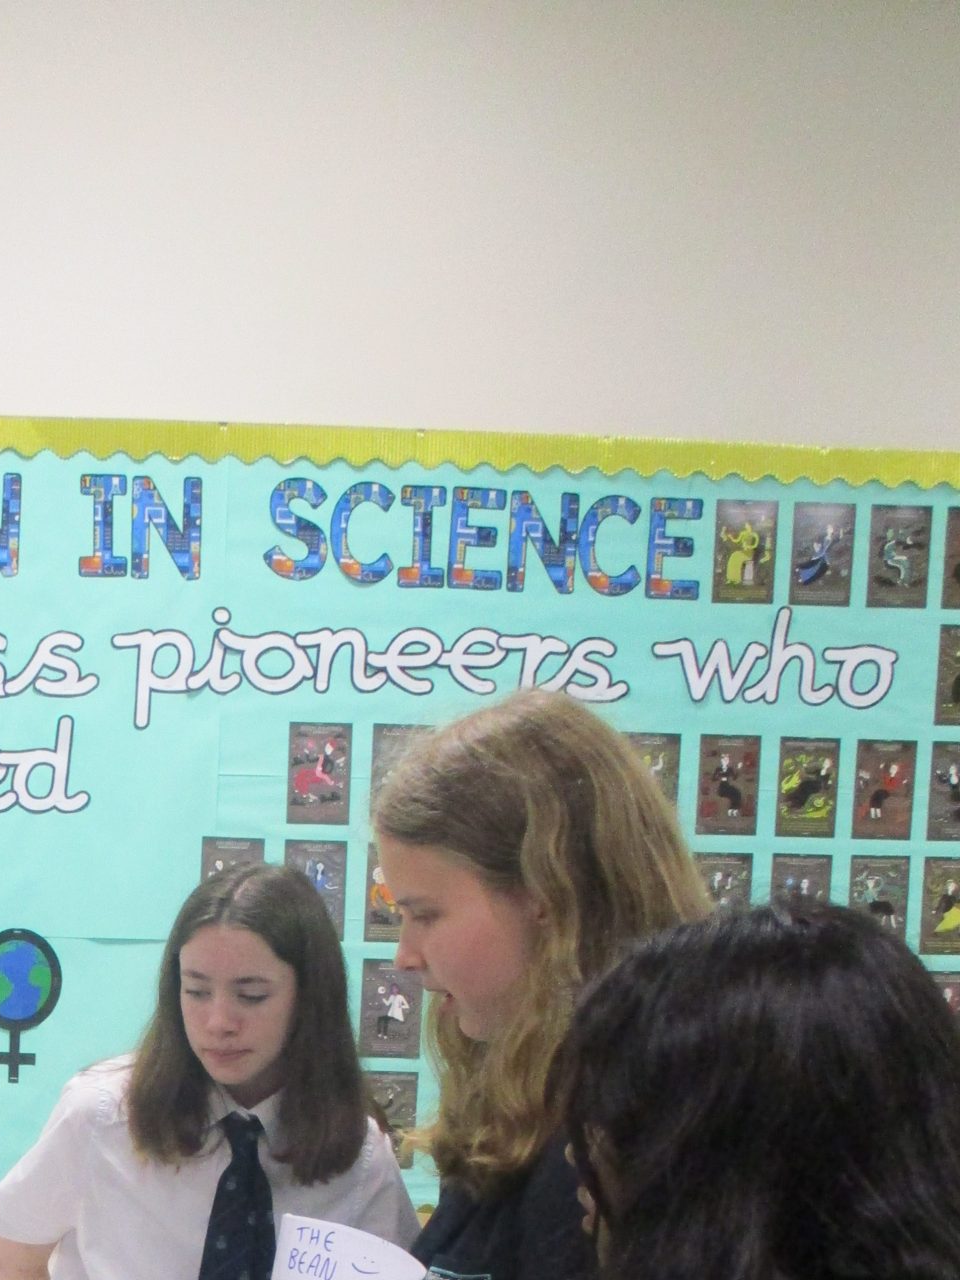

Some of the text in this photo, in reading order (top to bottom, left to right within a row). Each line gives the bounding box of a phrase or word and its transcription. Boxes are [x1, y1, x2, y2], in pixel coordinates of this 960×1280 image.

[79, 473, 203, 581] IN
[263, 477, 704, 600] SCIENCE
[112, 607, 630, 729] pioneers
[653, 605, 898, 710] who
[287, 1248, 337, 1280] BEAN
[297, 1226, 336, 1252] THE
